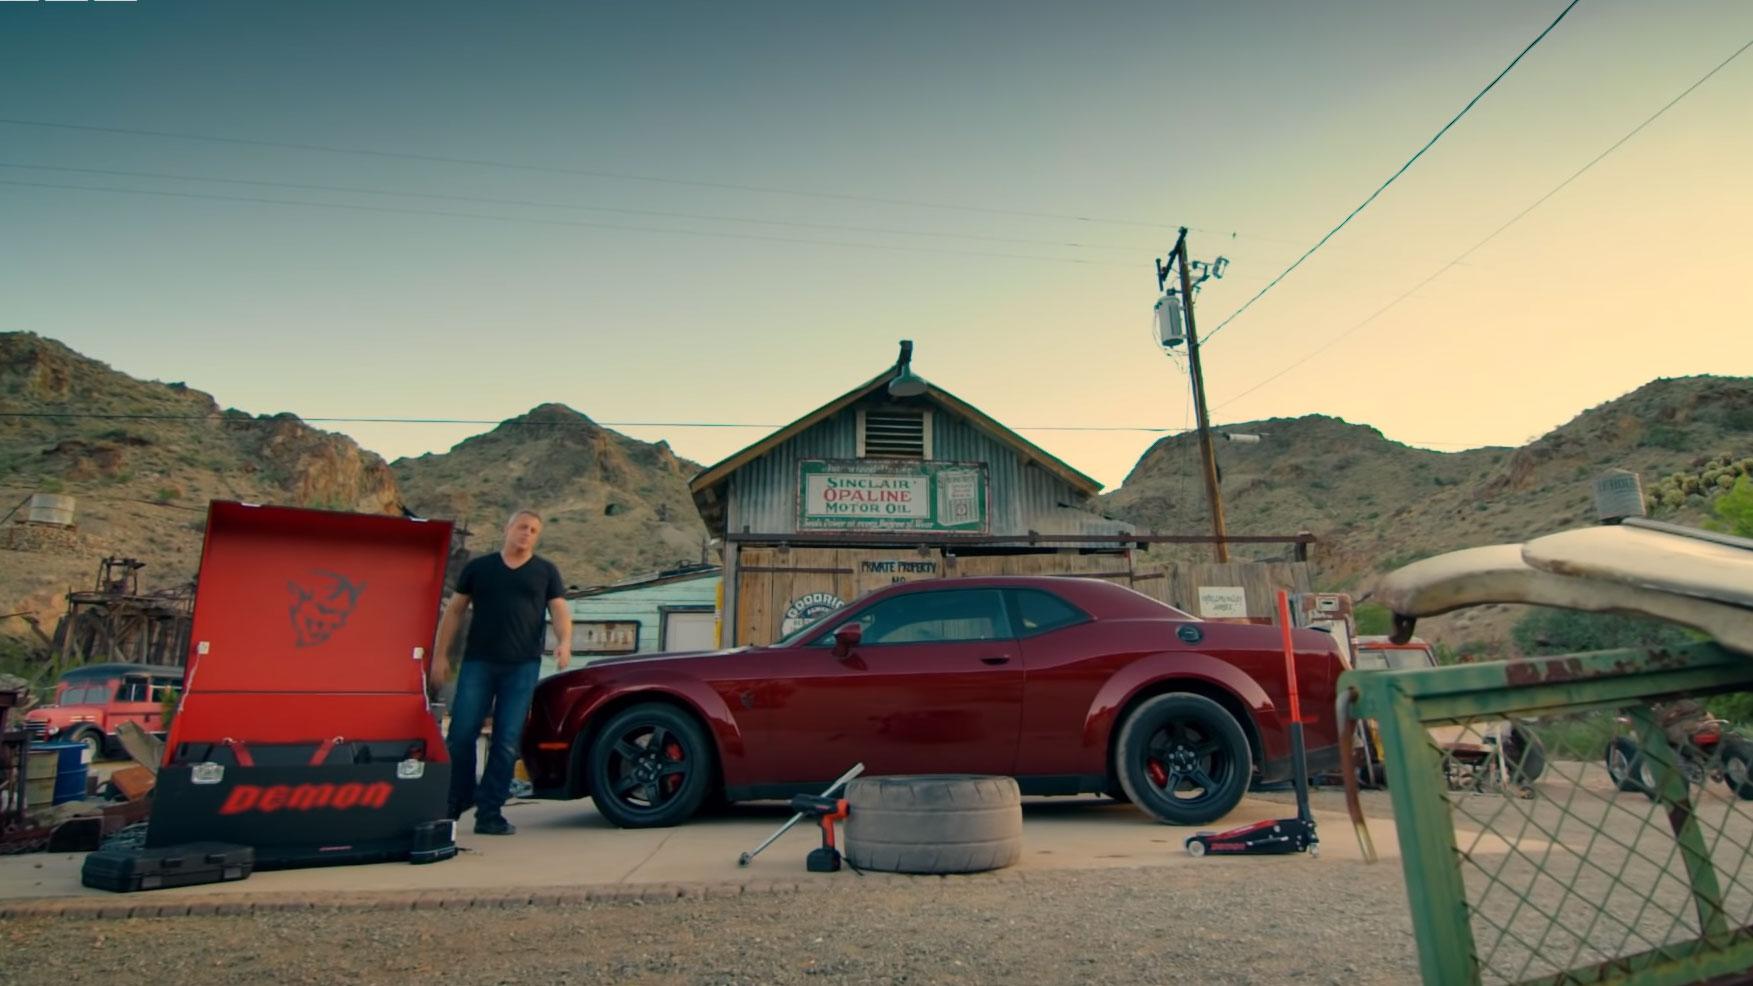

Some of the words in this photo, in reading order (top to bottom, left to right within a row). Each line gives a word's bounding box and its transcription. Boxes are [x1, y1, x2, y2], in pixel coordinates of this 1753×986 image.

[827, 477, 911, 489] SINCLAIR
[824, 488, 913, 502] OPALINE
[826, 502, 880, 513] MOTOR
[885, 503, 911, 514] OIL
[861, 561, 895, 573] PRIVATE
[897, 561, 937, 573] PROPERTY
